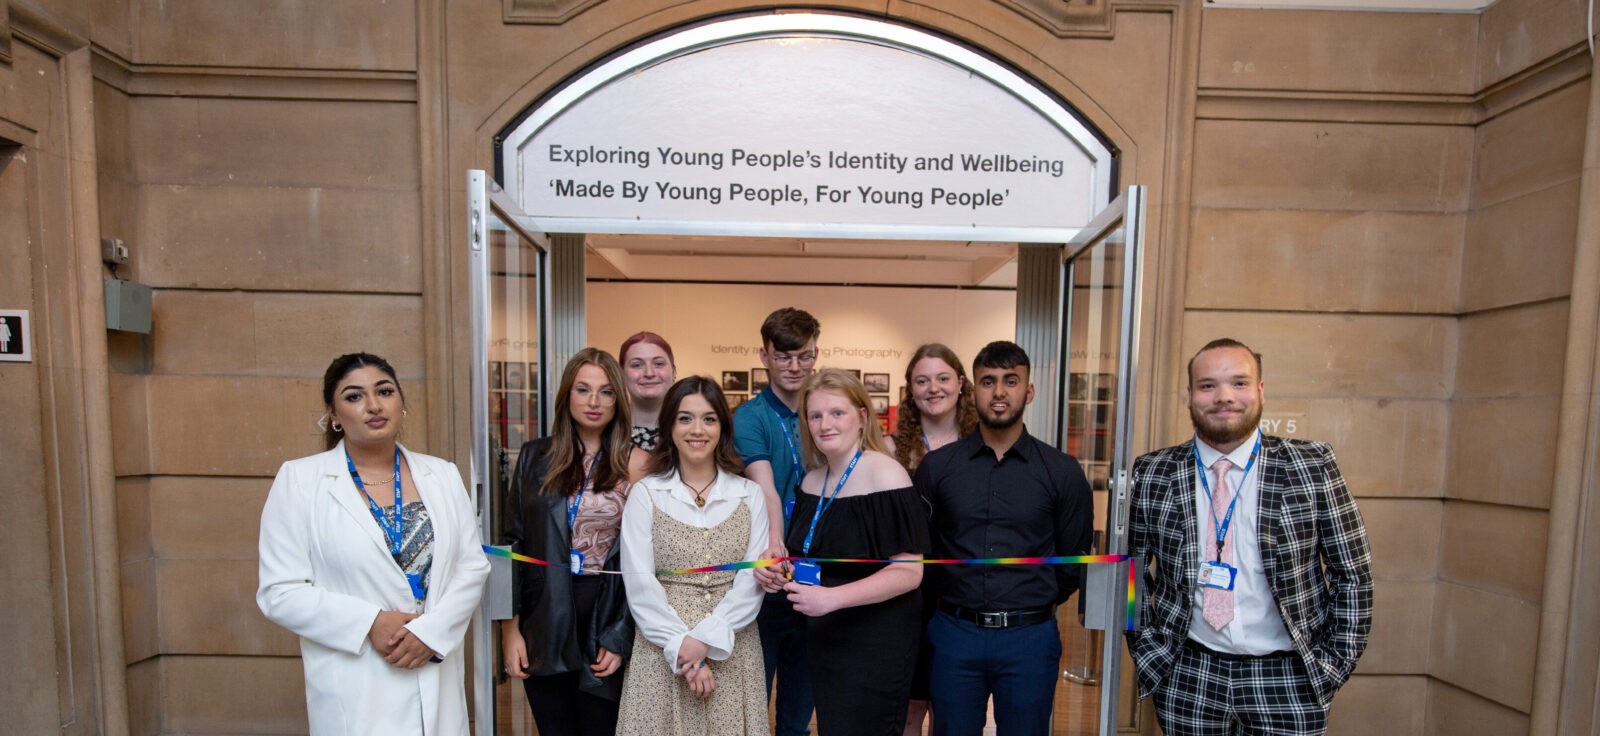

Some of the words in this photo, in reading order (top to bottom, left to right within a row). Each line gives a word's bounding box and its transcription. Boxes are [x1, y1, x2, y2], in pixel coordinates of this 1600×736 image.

[548, 144, 650, 168] Exploring
[657, 147, 724, 170] Young
[731, 148, 822, 171] People’s
[828, 150, 908, 173] Identity
[914, 153, 954, 171] and
[960, 153, 1064, 177] Wellbeing
[622, 180, 649, 202] By
[655, 181, 722, 204] Young
[729, 183, 809, 206] People,
[816, 184, 851, 203] For
[857, 185, 923, 209] Young
[711, 344, 750, 356] Identity
[833, 346, 903, 359] Photography
[1286, 419, 1297, 434] 5
